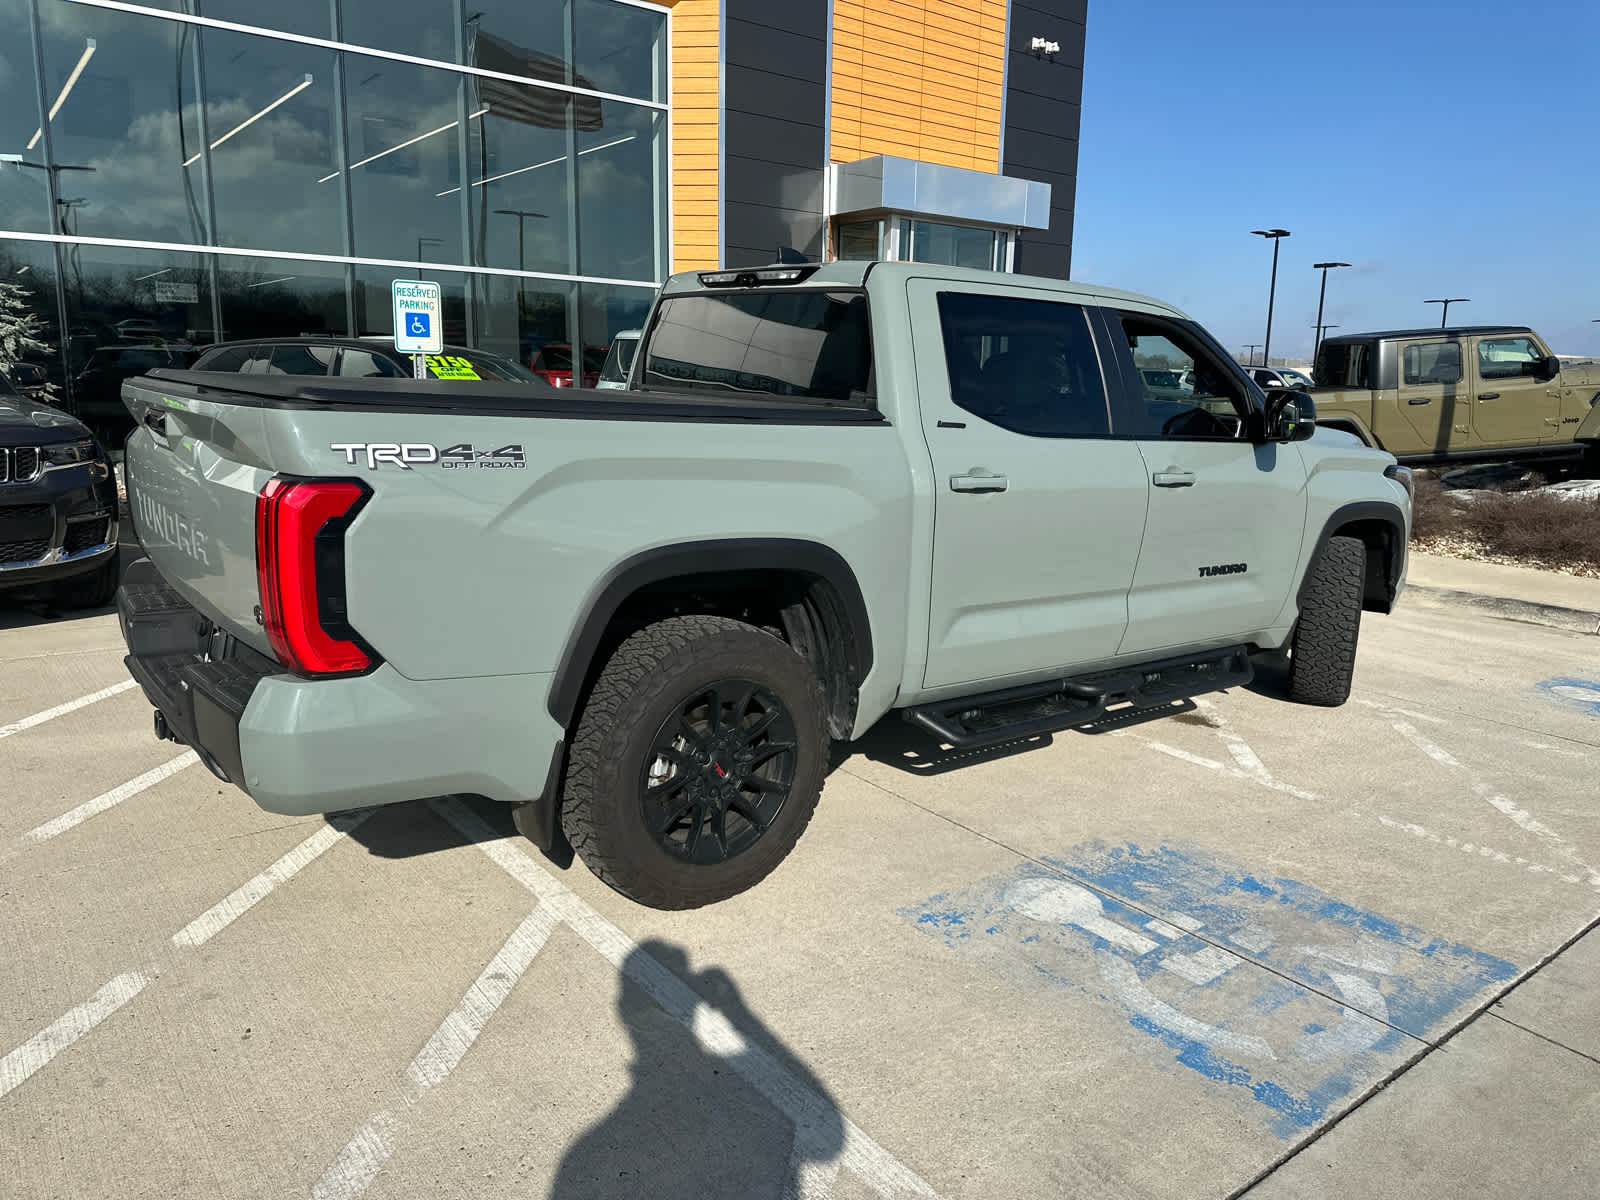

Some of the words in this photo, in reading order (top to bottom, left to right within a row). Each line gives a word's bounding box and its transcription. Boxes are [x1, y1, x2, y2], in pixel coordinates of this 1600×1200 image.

[396, 287, 437, 299] RESERVED
[399, 299, 435, 311] PARKING
[330, 443, 439, 471] TRD
[440, 444, 526, 462] 4x4
[441, 461, 473, 469] OFF
[480, 461, 526, 469] ROAD
[1198, 563, 1248, 578] TUNDRA
